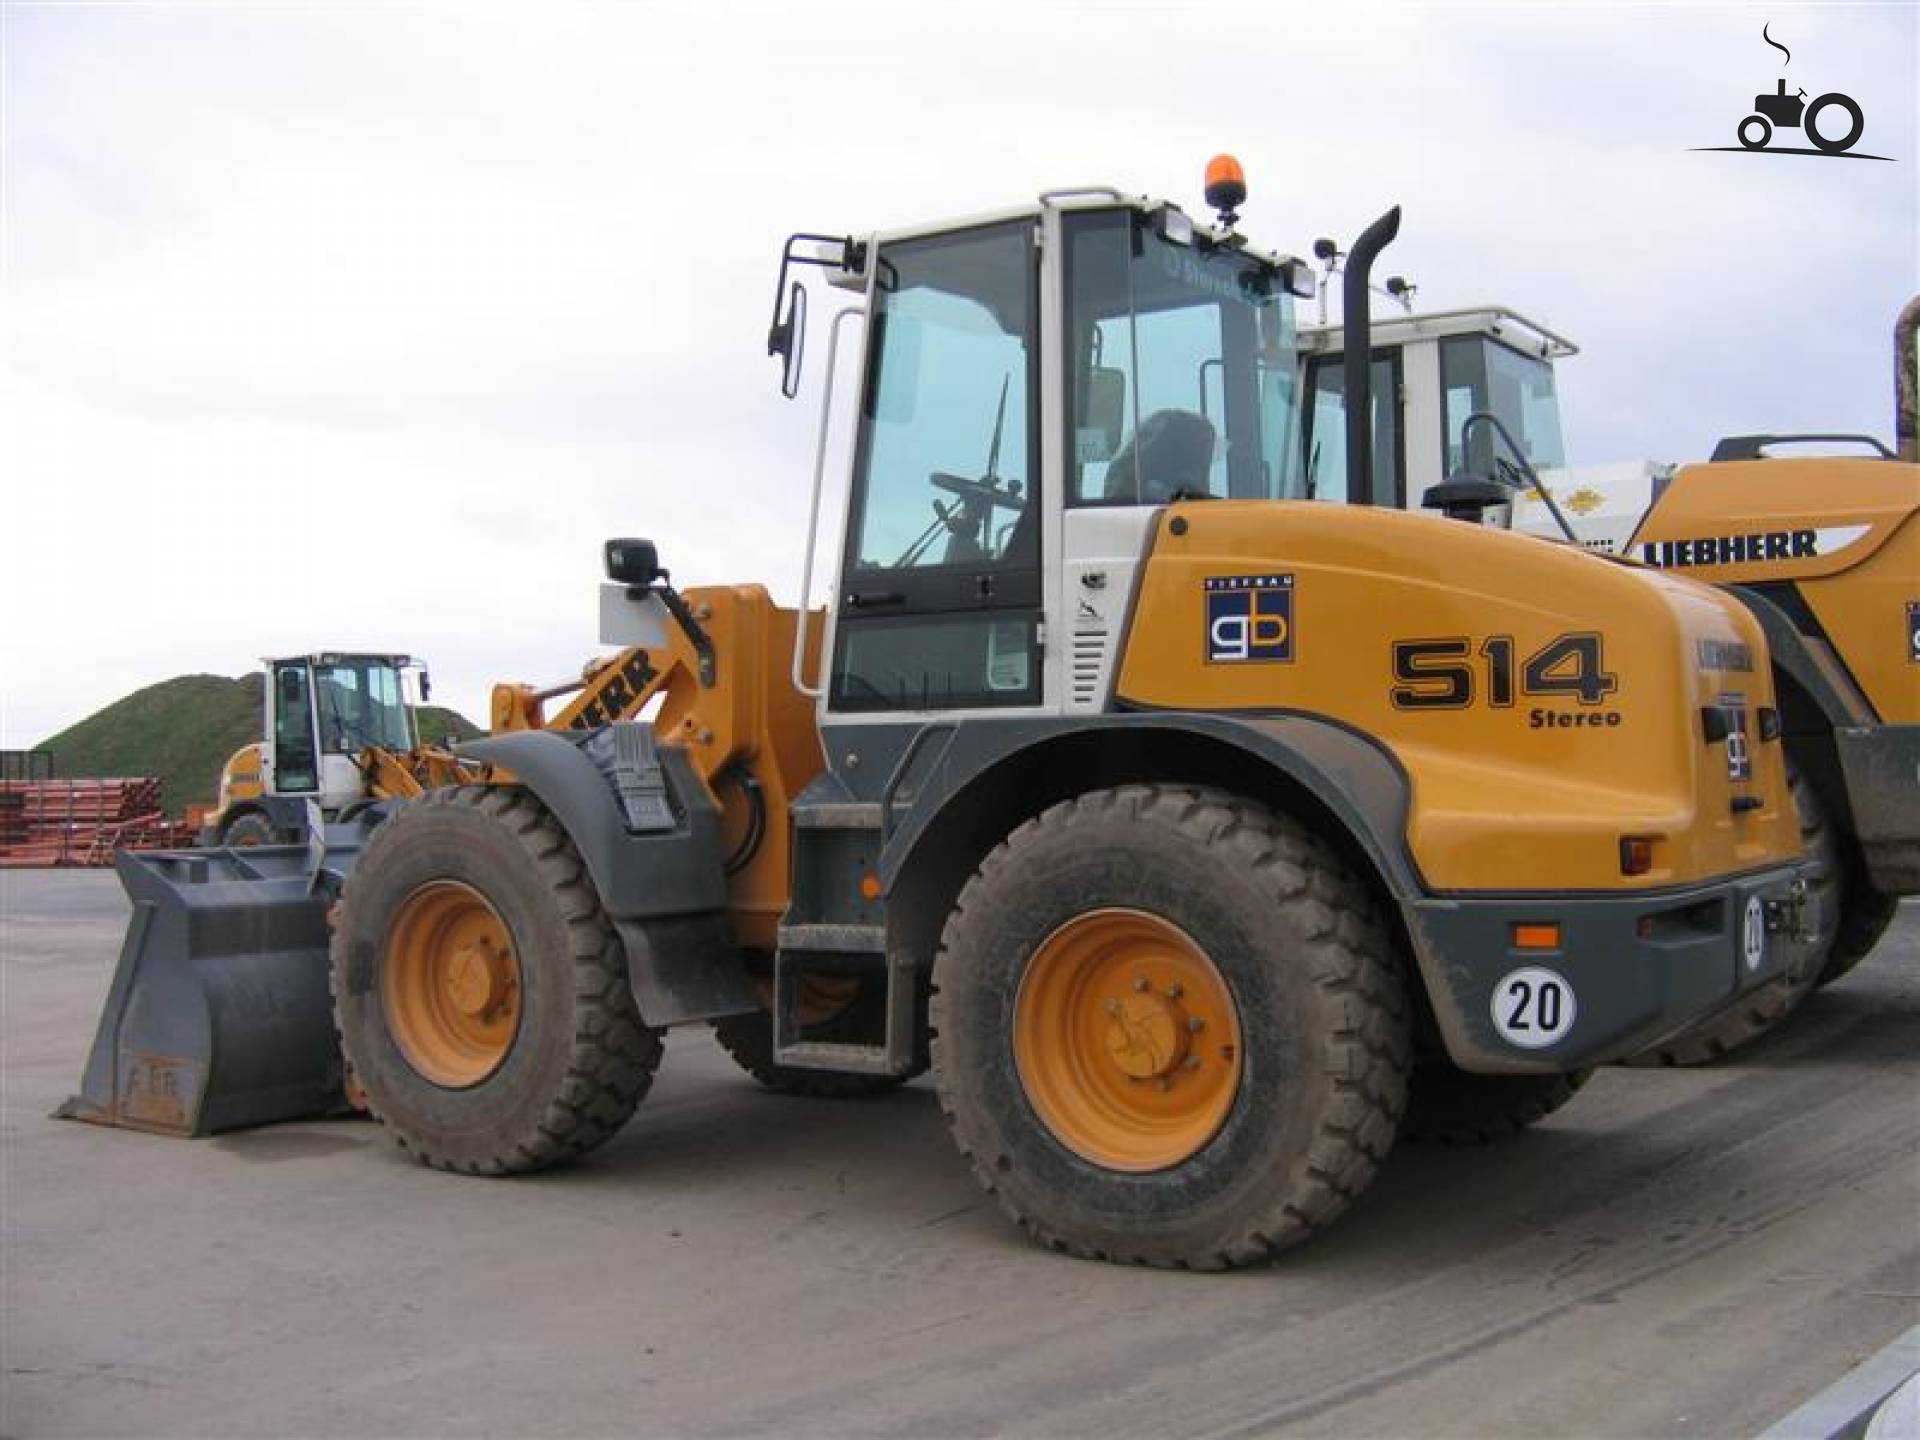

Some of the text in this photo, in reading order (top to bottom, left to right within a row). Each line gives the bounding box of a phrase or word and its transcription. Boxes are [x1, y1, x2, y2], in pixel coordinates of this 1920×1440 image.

[1643, 529, 1818, 569] LIEBHERR
[1211, 591, 1287, 659] gb
[570, 648, 660, 730] ERR
[1390, 631, 1618, 711] 514
[1529, 709, 1622, 730] Stereo
[1507, 981, 1562, 1031] 20
